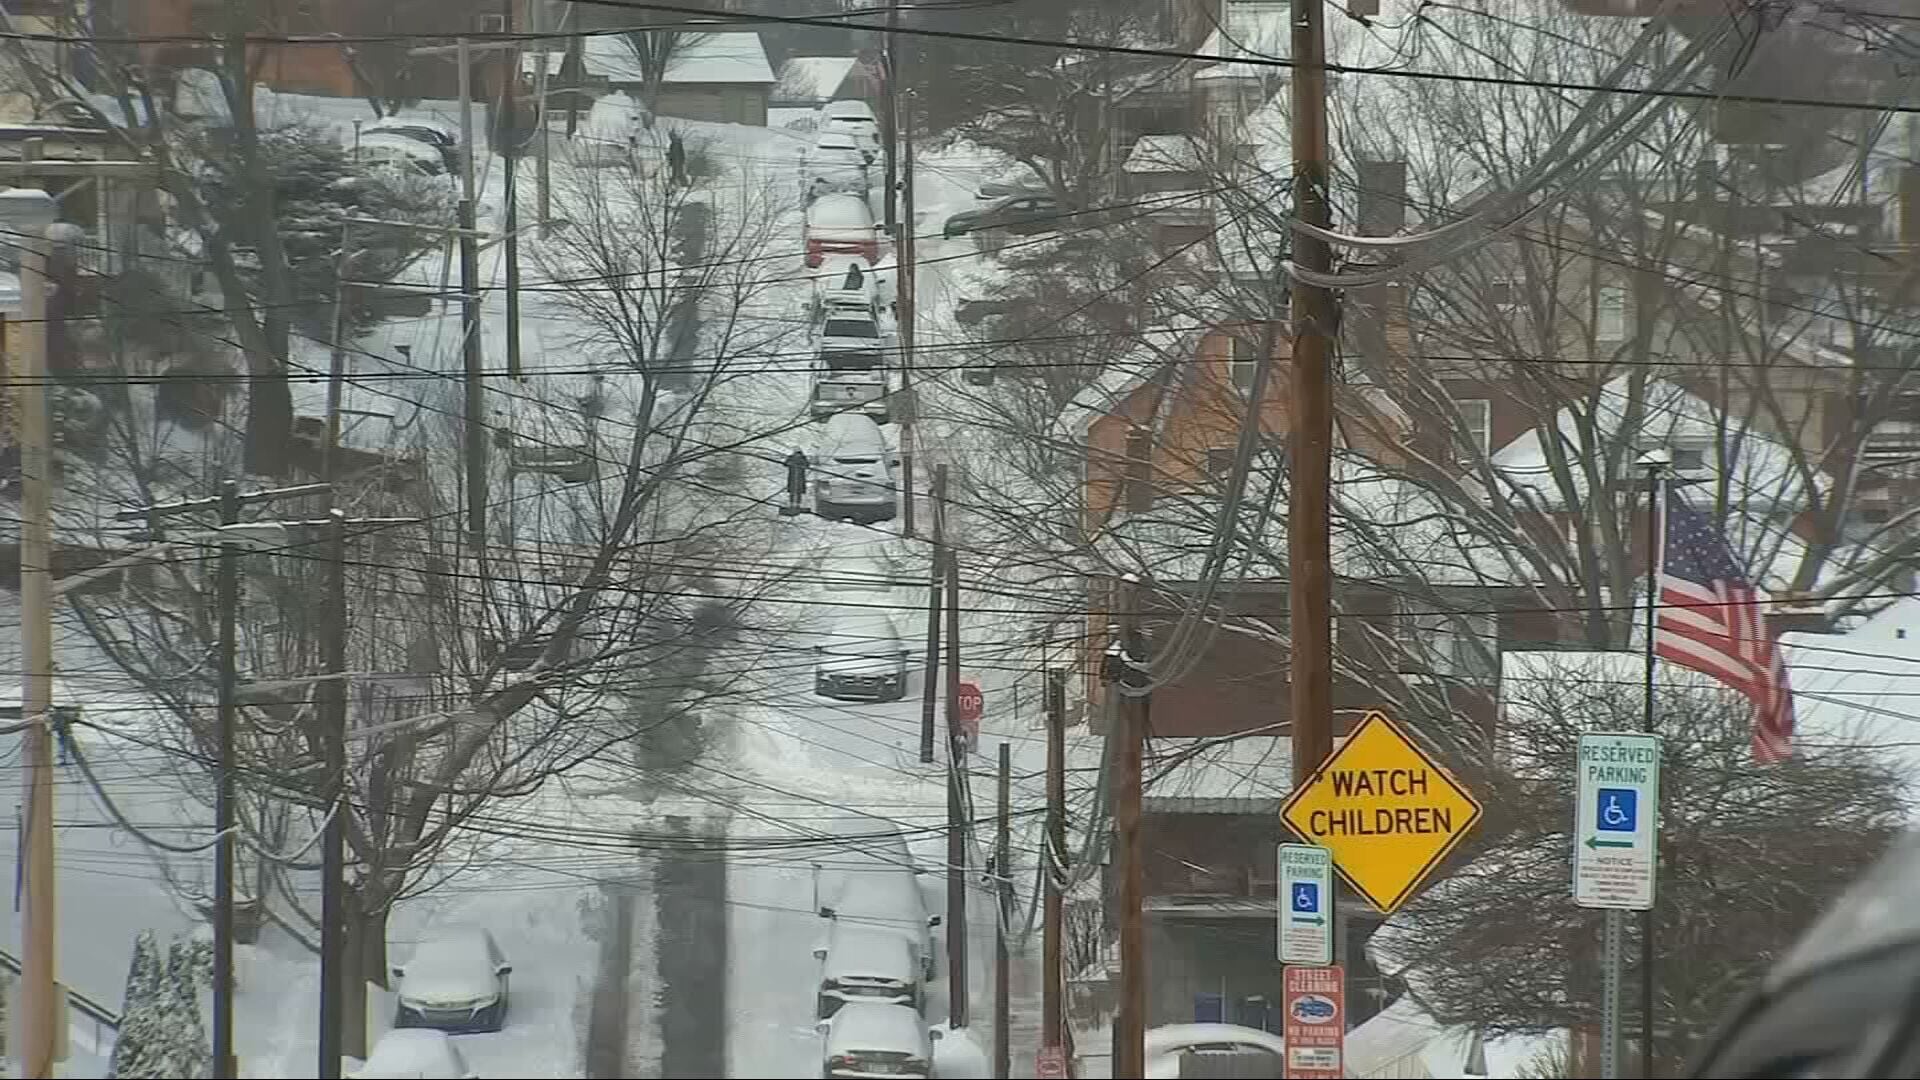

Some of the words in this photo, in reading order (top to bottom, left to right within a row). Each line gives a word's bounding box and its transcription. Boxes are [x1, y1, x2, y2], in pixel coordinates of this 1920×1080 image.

[957, 695, 982, 710] TOP
[1582, 746, 1654, 763] RESERVED
[1588, 766, 1647, 784] PARKING
[1331, 769, 1427, 797] WATCH
[1310, 807, 1451, 837] CHILDREN
[1281, 851, 1326, 865] RESERVED
[1597, 857, 1633, 866] NOTICE
[1286, 865, 1323, 879] PARKING
[1294, 969, 1331, 981] STREET
